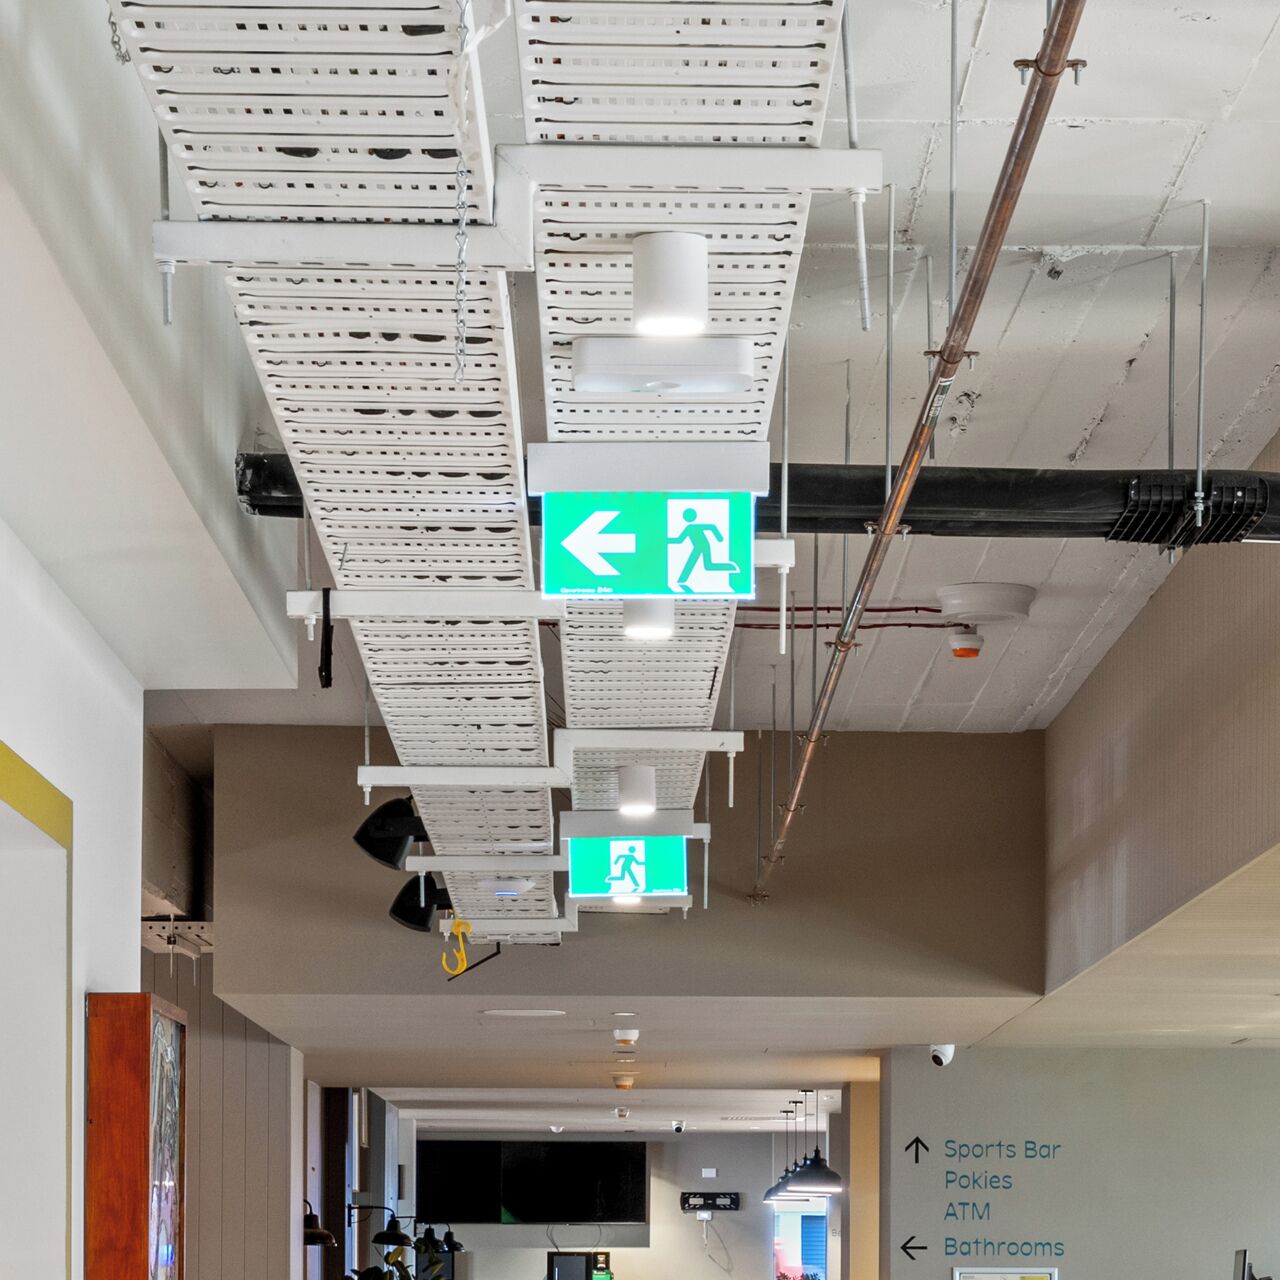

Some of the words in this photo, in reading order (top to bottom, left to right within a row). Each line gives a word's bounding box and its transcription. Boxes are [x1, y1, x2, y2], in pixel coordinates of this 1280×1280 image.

[944, 1139, 1017, 1162] Sports
[1024, 1139, 1062, 1160] Bar
[944, 1170, 1013, 1190] Pokies
[943, 1202, 991, 1221] ATM
[944, 1236, 1065, 1257] Bathrooms
